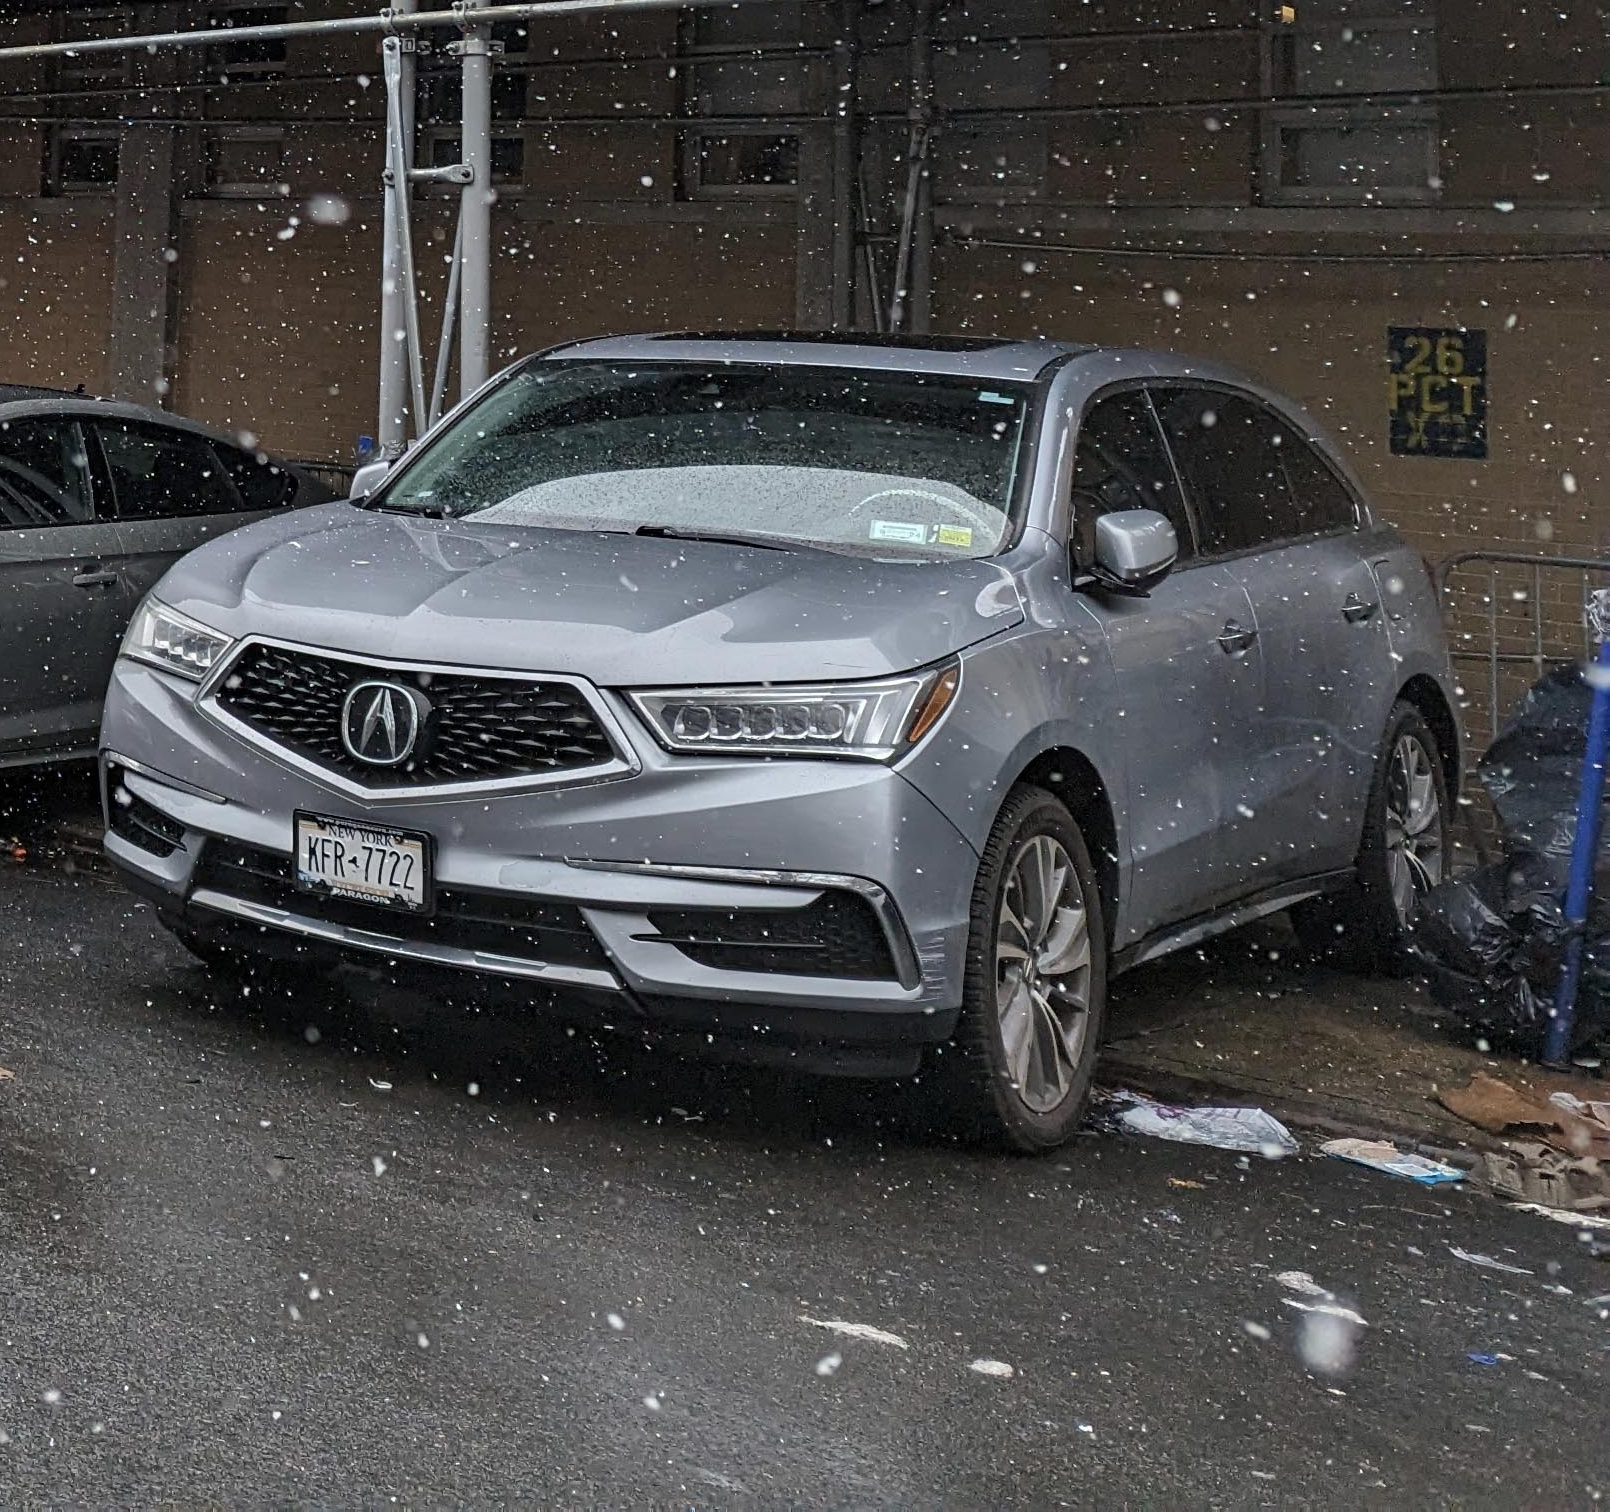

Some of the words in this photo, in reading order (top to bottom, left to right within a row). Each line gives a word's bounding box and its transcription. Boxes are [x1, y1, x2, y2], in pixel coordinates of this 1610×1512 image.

[1404, 335, 1464, 376] 26
[1389, 373, 1481, 417] PCT
[328, 824, 356, 841] NEW
[358, 830, 393, 848] YORK
[308, 835, 415, 891] KFR-7722
[330, 887, 391, 905] PARAGON
